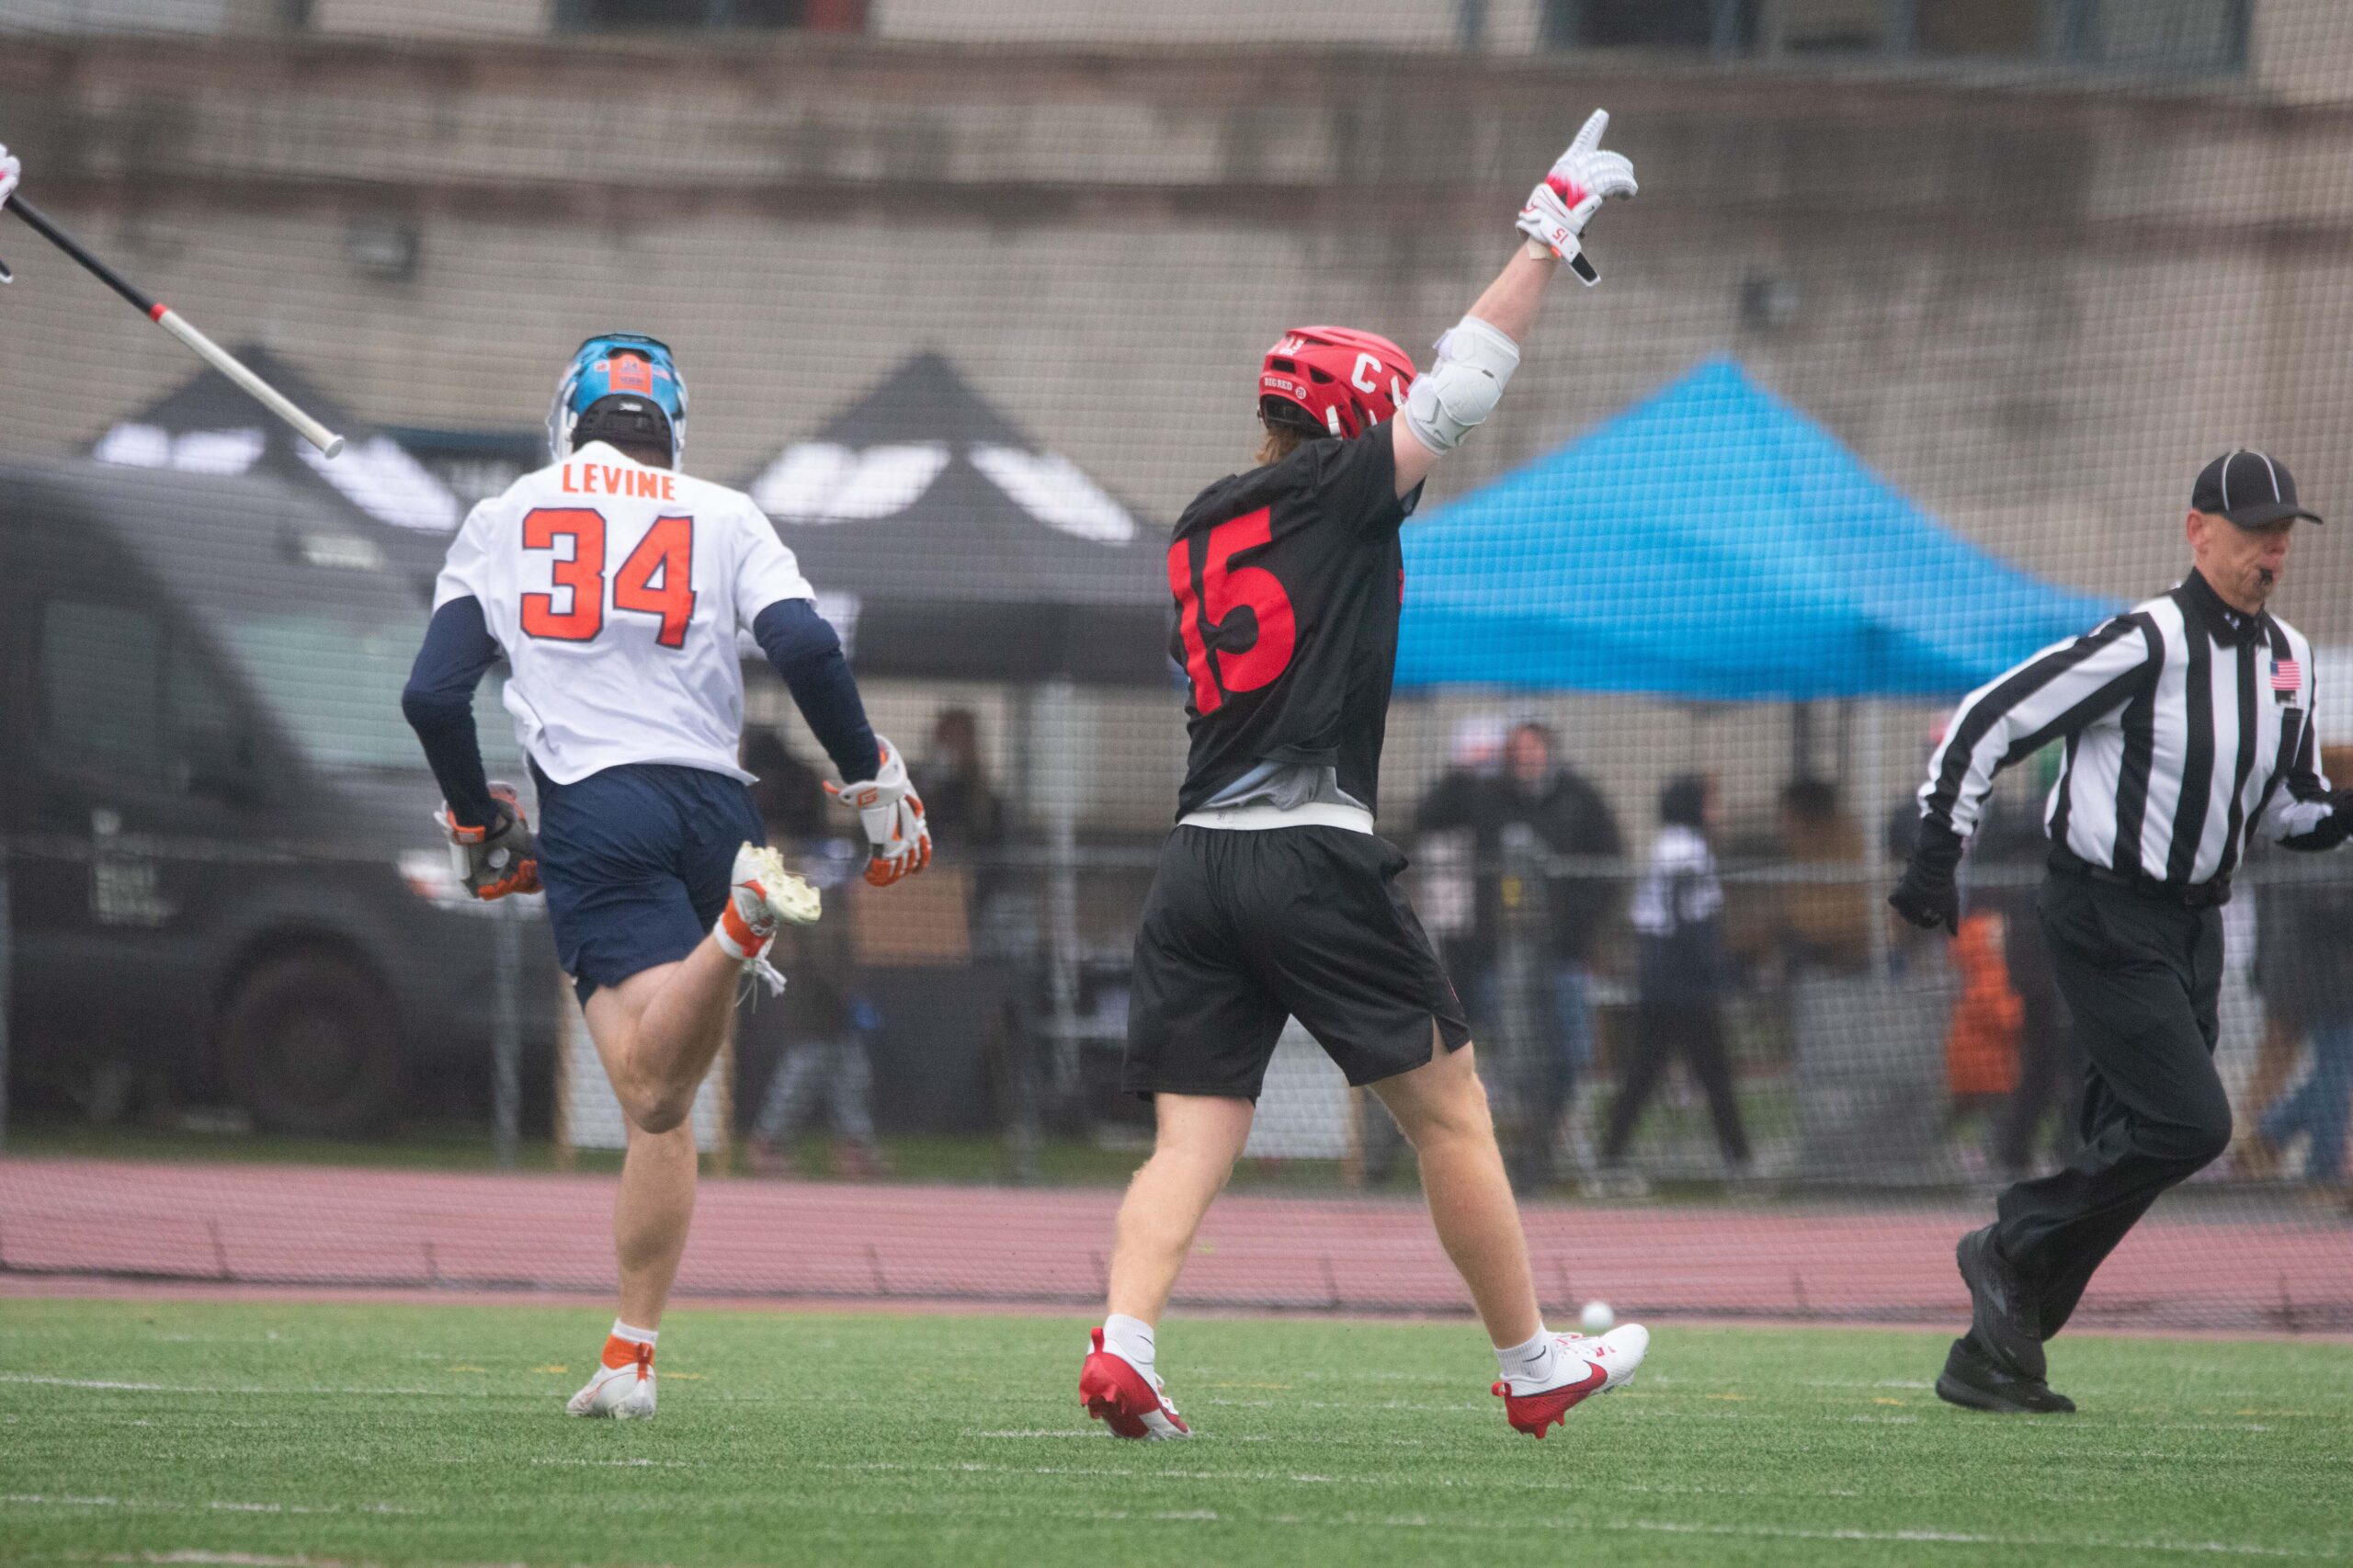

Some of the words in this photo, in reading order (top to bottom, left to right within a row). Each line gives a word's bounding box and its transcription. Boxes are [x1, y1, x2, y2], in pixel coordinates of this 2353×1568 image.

[1552, 227, 1569, 244] 15
[1278, 379, 1292, 392] RED
[1351, 352, 1382, 394] C
[562, 463, 677, 501] LEVINE
[519, 507, 698, 651] 34
[1167, 506, 1296, 717] 15
